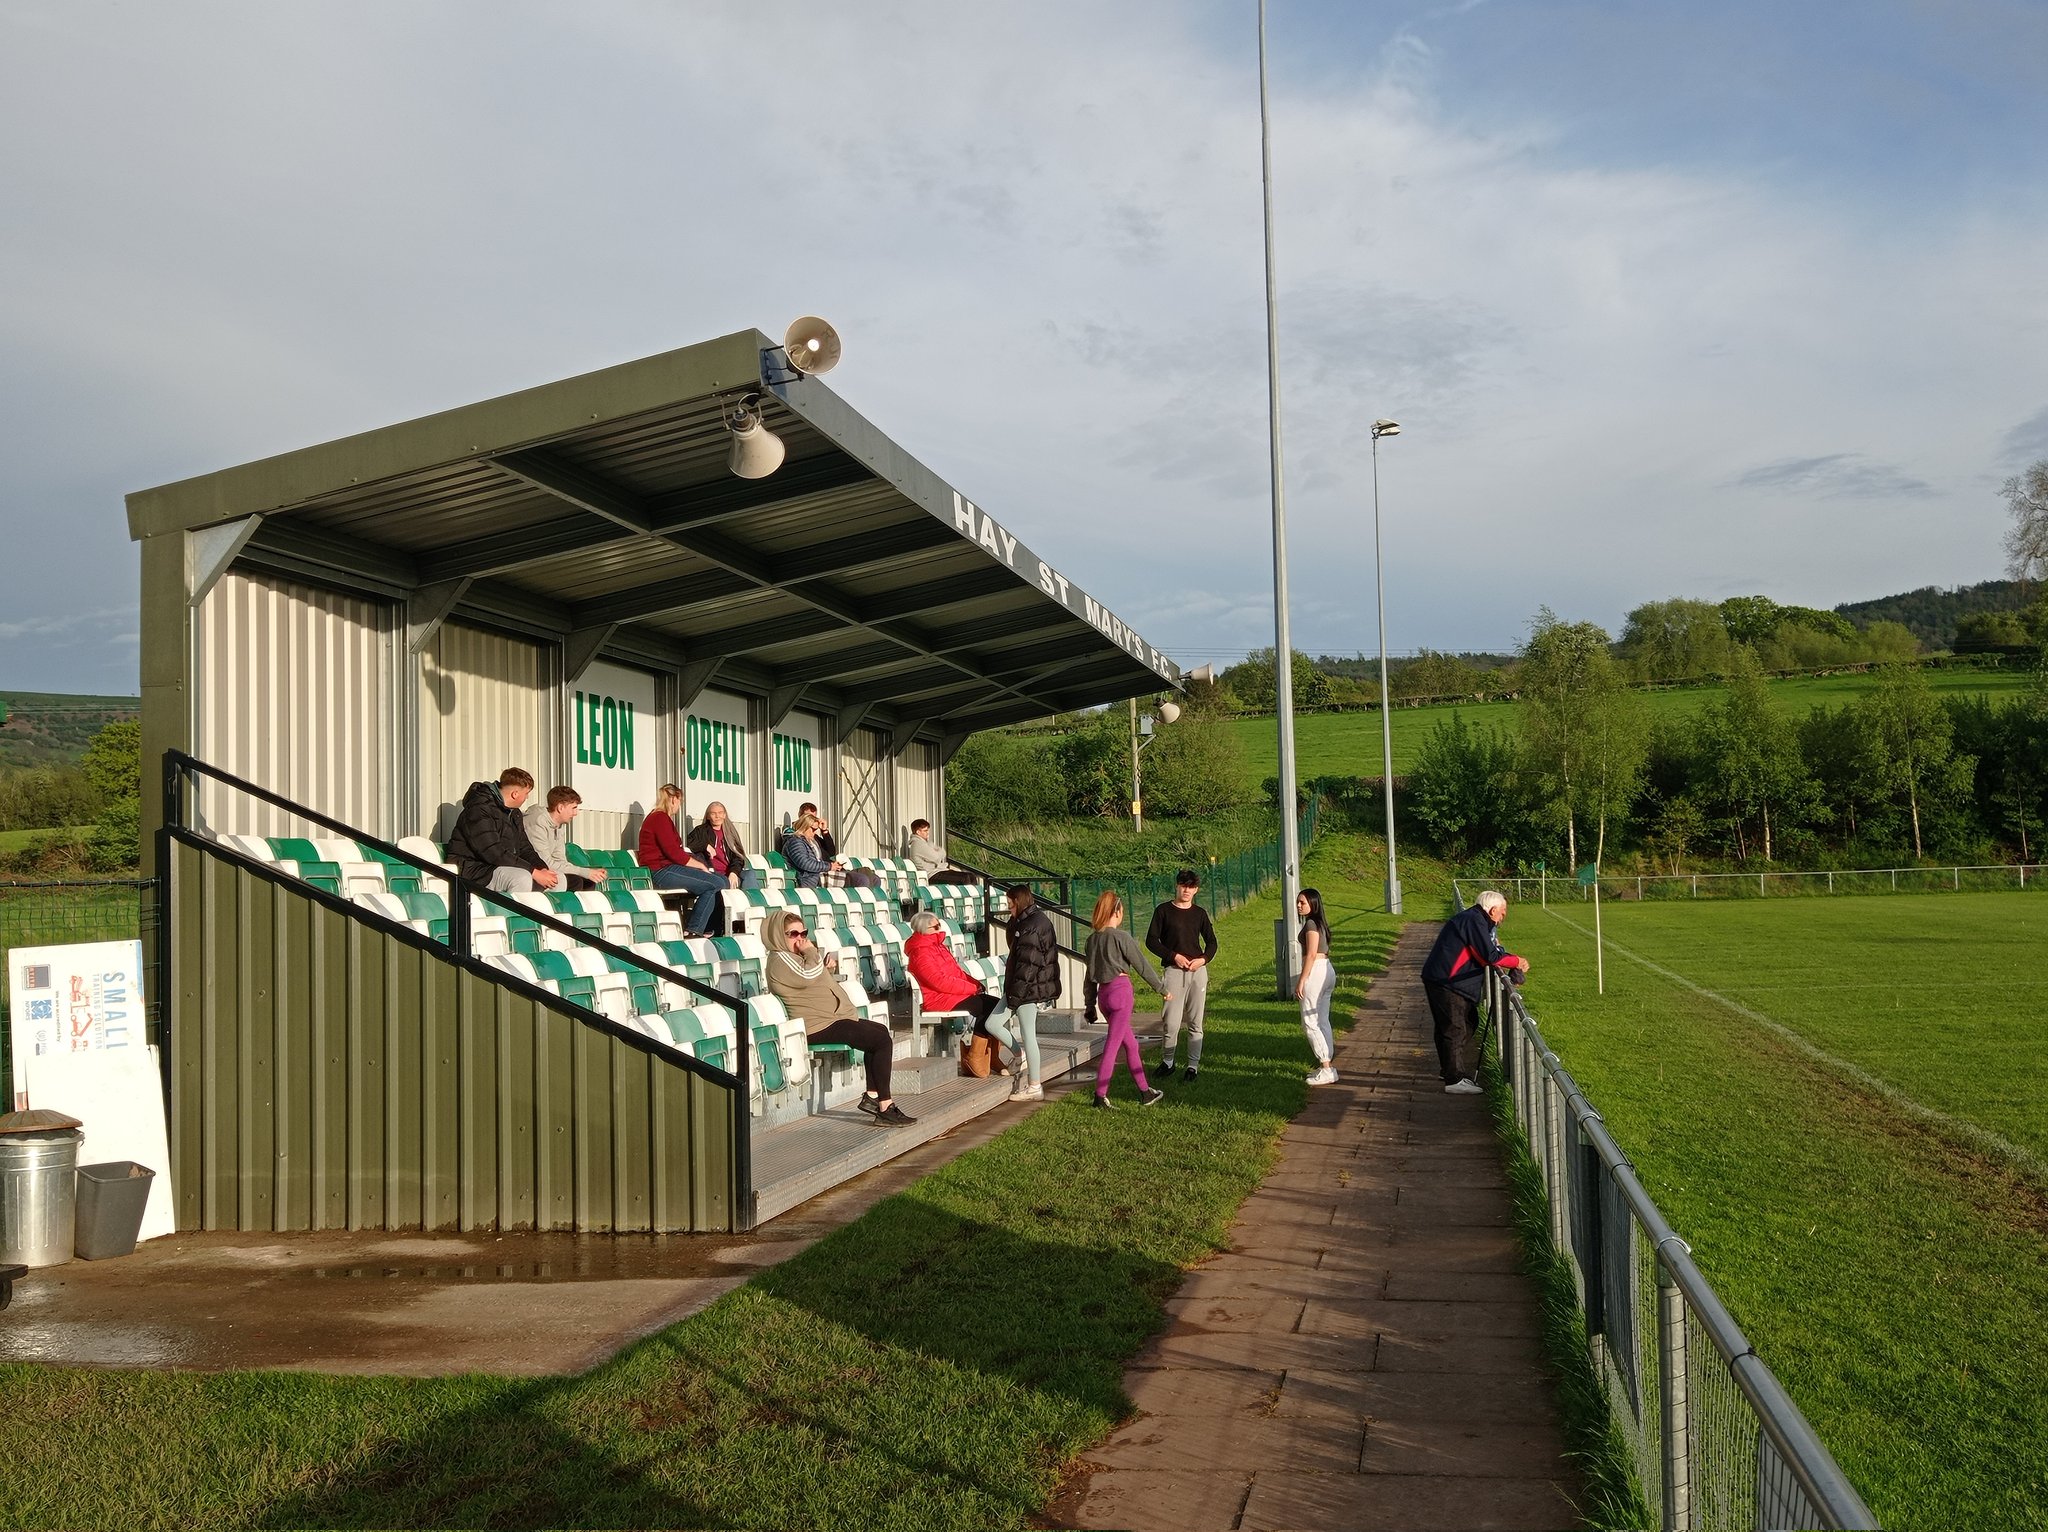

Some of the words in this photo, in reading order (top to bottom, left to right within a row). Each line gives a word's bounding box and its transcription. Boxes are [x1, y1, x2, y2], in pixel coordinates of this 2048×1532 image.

[953, 490, 1017, 566] HAY
[1038, 561, 1069, 605] ST
[1084, 594, 1144, 660] MARY'S
[575, 690, 635, 771] LEON
[686, 714, 746, 786] ORELLI
[773, 733, 812, 793] TAND
[93, 973, 101, 1009] TRAINING
